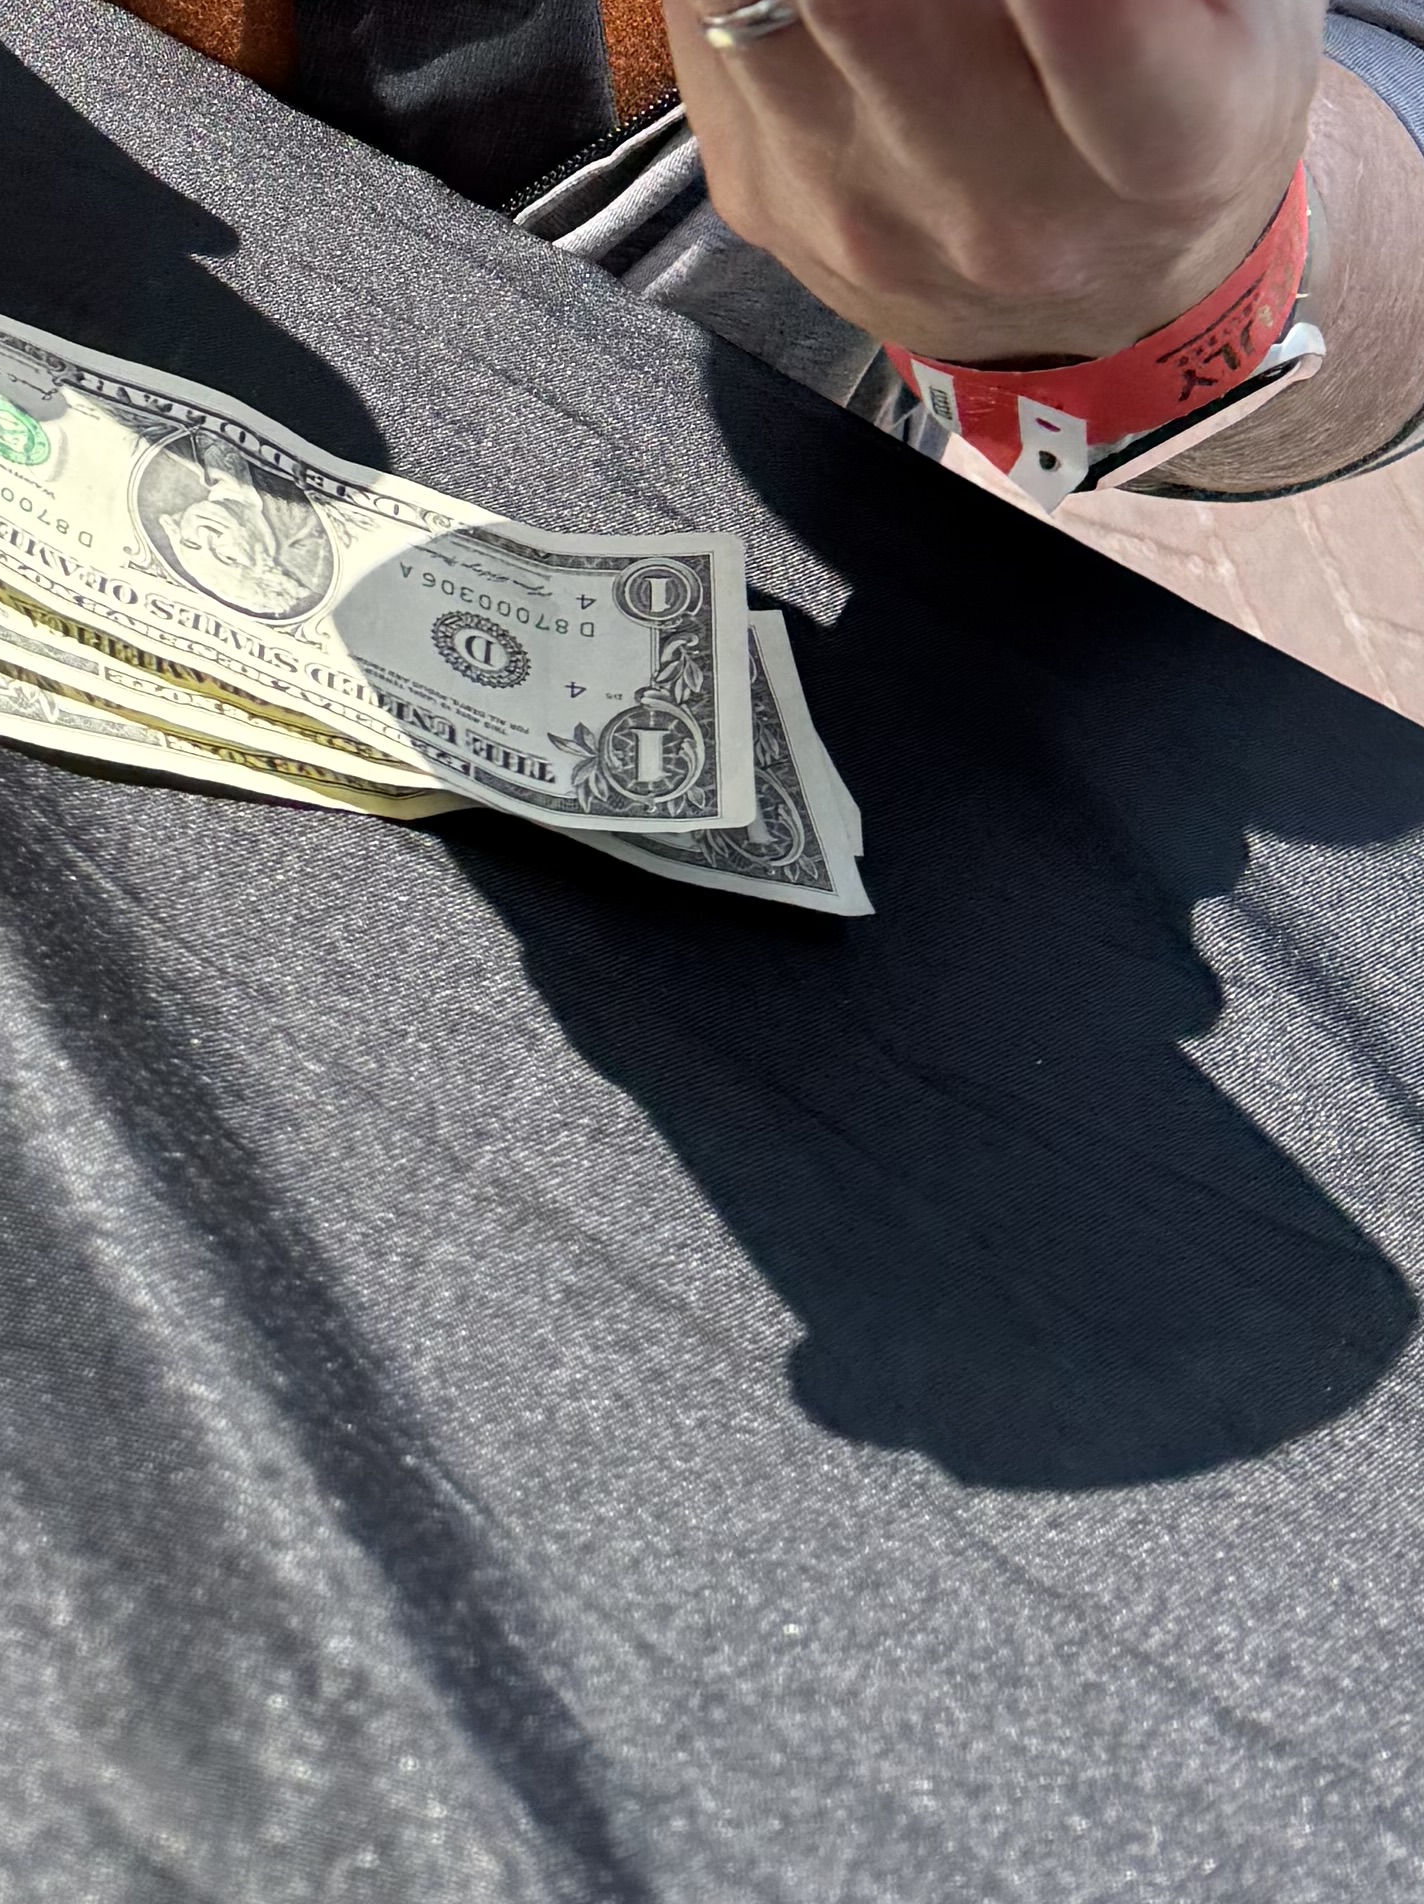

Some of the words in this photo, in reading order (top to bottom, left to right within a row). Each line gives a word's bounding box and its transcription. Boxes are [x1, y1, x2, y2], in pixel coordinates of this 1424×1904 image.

[575, 593, 596, 608] 4
[141, 593, 299, 673] STATES
[464, 634, 494, 667] D
[306, 663, 456, 745] UNITED
[564, 680, 586, 697] 4
[466, 730, 554, 783] THE
